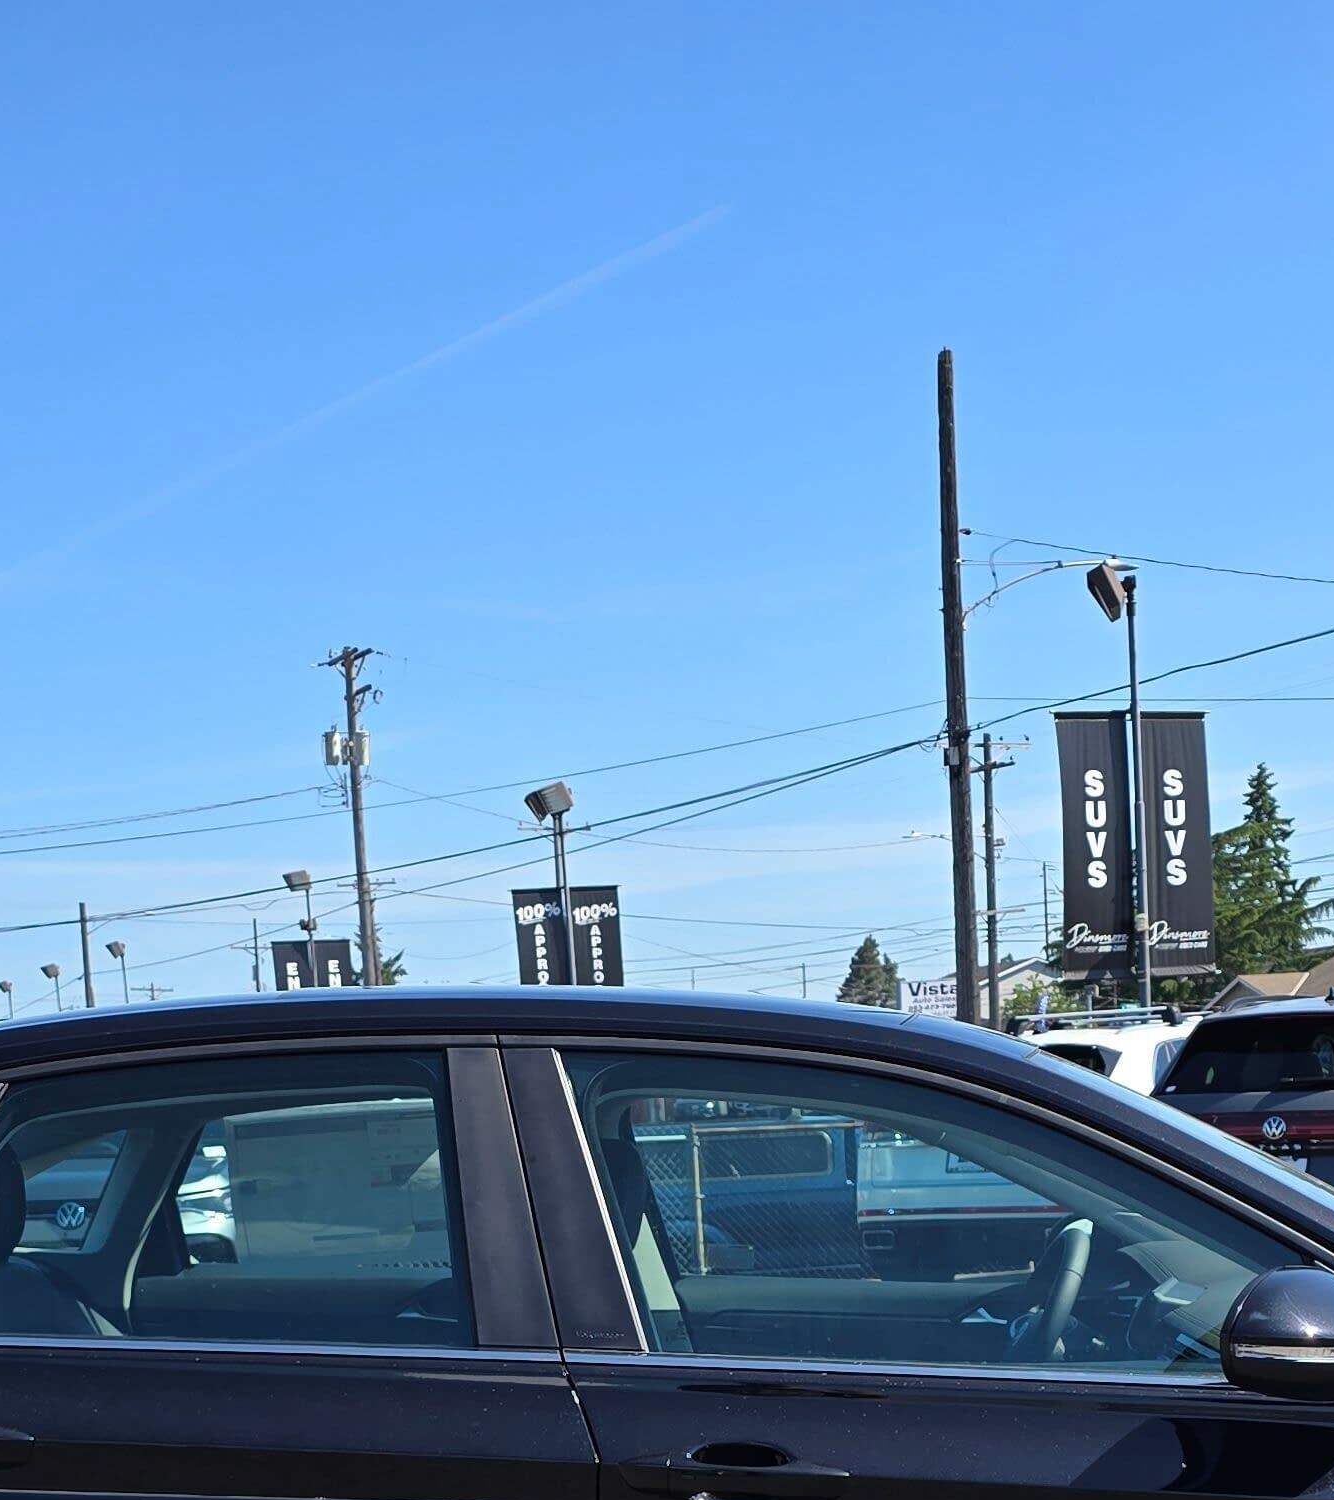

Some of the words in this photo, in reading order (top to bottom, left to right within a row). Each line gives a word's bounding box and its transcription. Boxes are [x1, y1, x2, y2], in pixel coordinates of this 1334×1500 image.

[1083, 769, 1108, 889] SUVS
[1162, 768, 1188, 886] SUVS
[516, 902, 561, 921] 100%
[572, 902, 617, 921] 100%
[534, 923, 550, 985] APPRO
[590, 924, 605, 986] APPRO
[908, 981, 957, 997] Vista
